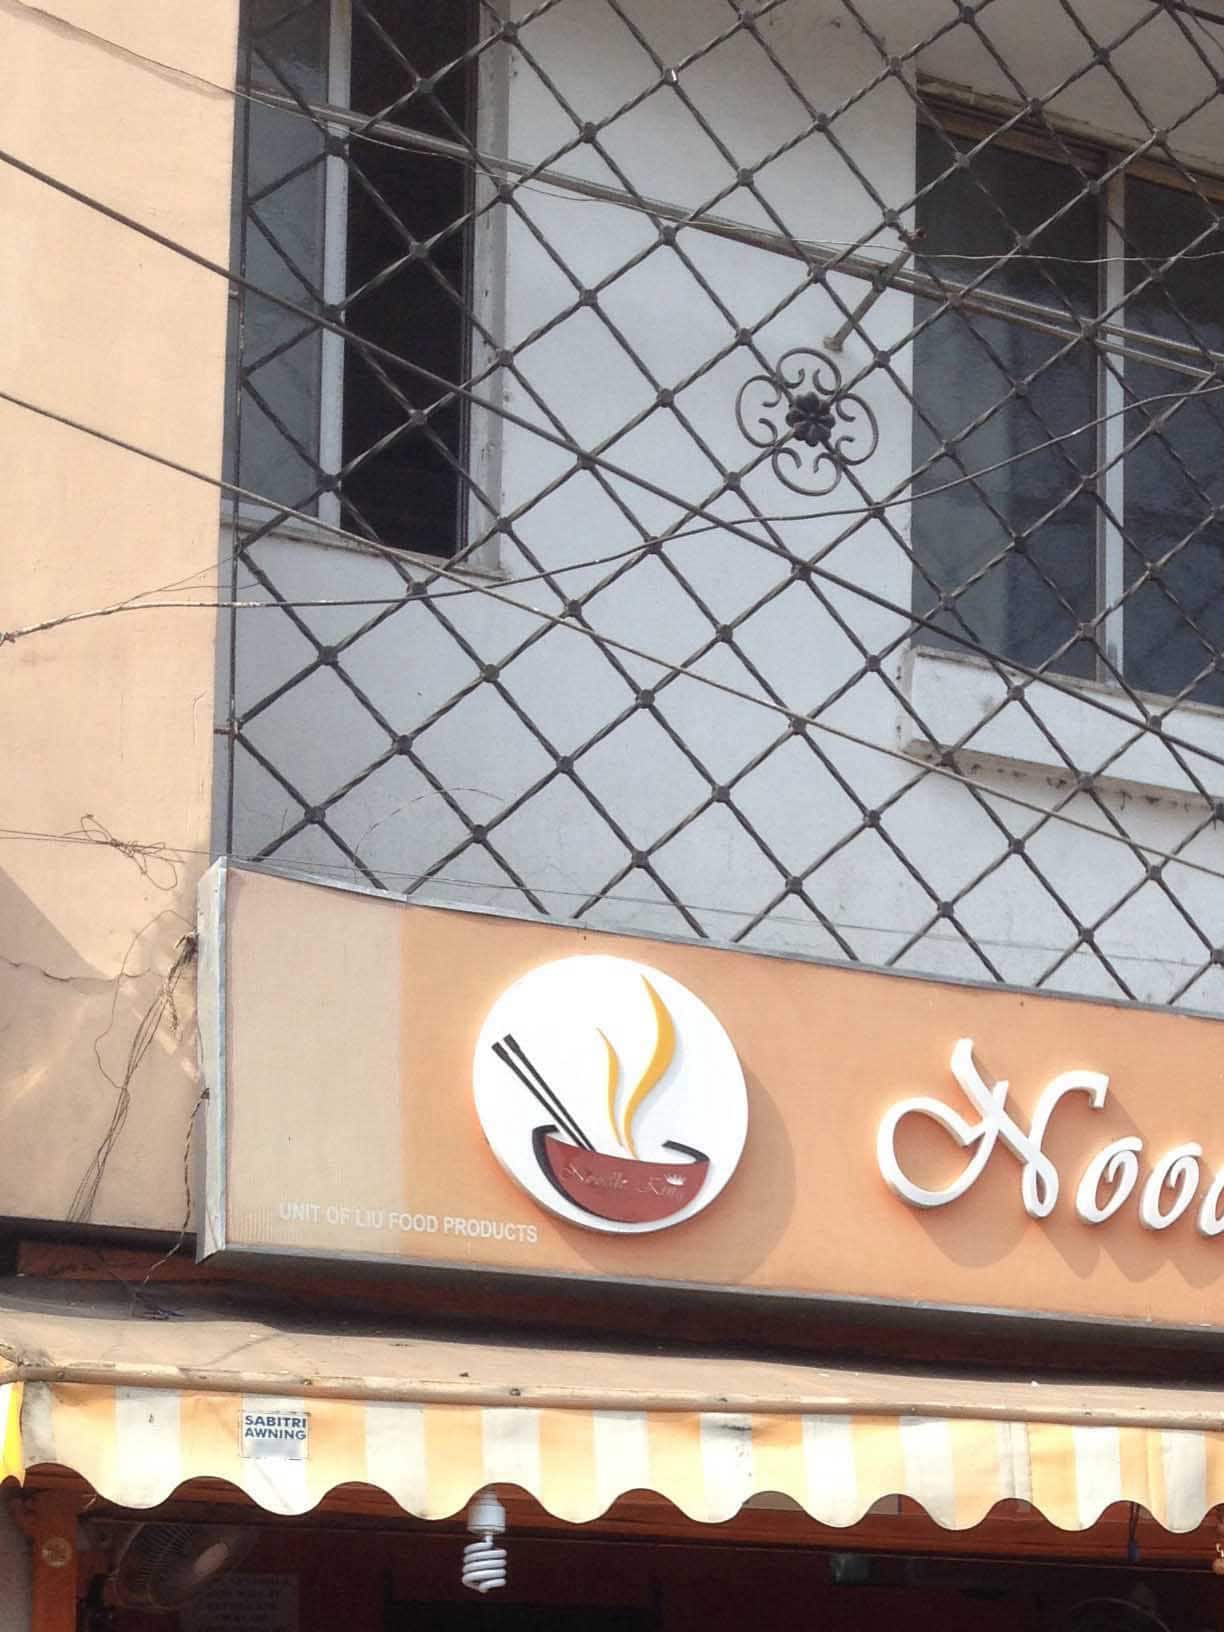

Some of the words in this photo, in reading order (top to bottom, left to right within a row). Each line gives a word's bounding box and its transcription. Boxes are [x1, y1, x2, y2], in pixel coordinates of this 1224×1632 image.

[279, 1200, 321, 1224] UNIT
[326, 1205, 351, 1226] OF
[353, 1208, 384, 1229] LIU
[388, 1211, 438, 1234] FOOD
[443, 1216, 539, 1244] PRODUCTS
[244, 1415, 307, 1428] SABITRI
[244, 1427, 307, 1441] AWNING
